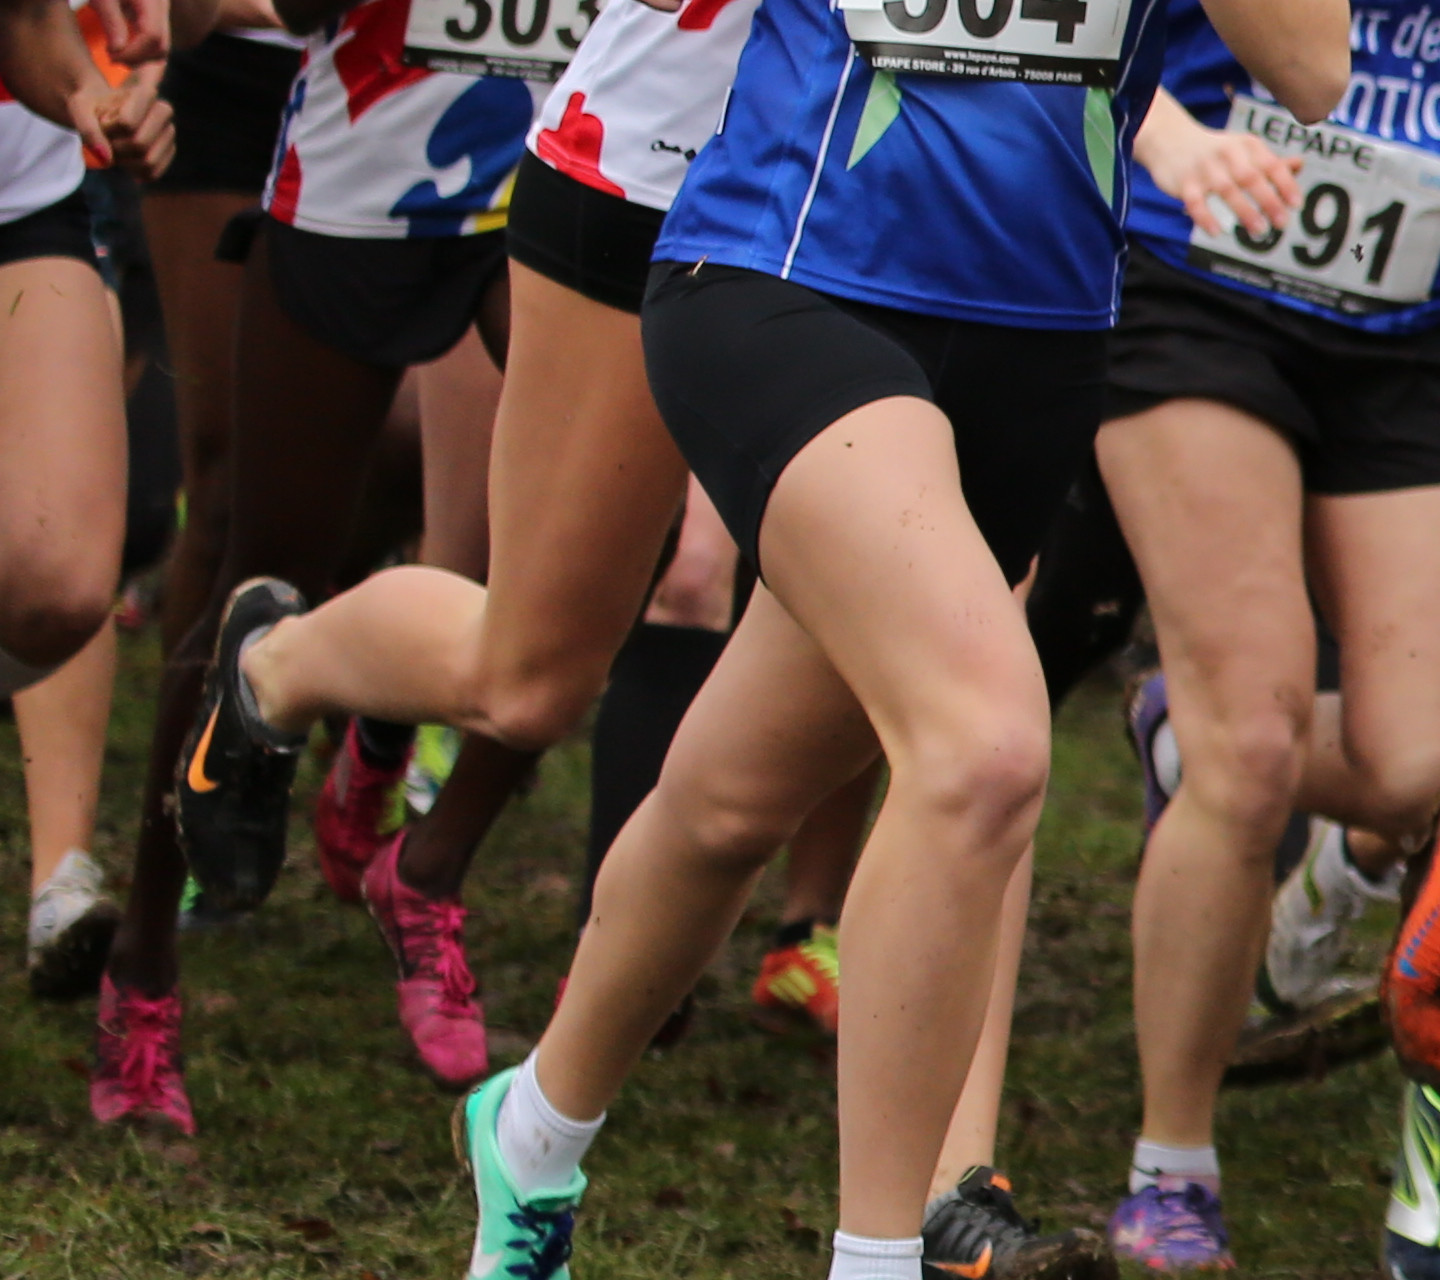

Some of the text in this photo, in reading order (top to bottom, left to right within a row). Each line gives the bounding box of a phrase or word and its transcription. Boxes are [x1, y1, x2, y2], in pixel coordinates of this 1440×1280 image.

[872, 56, 911, 70] LEPAPE
[912, 59, 946, 73] STORE
[1246, 108, 1374, 170] LEPAPE
